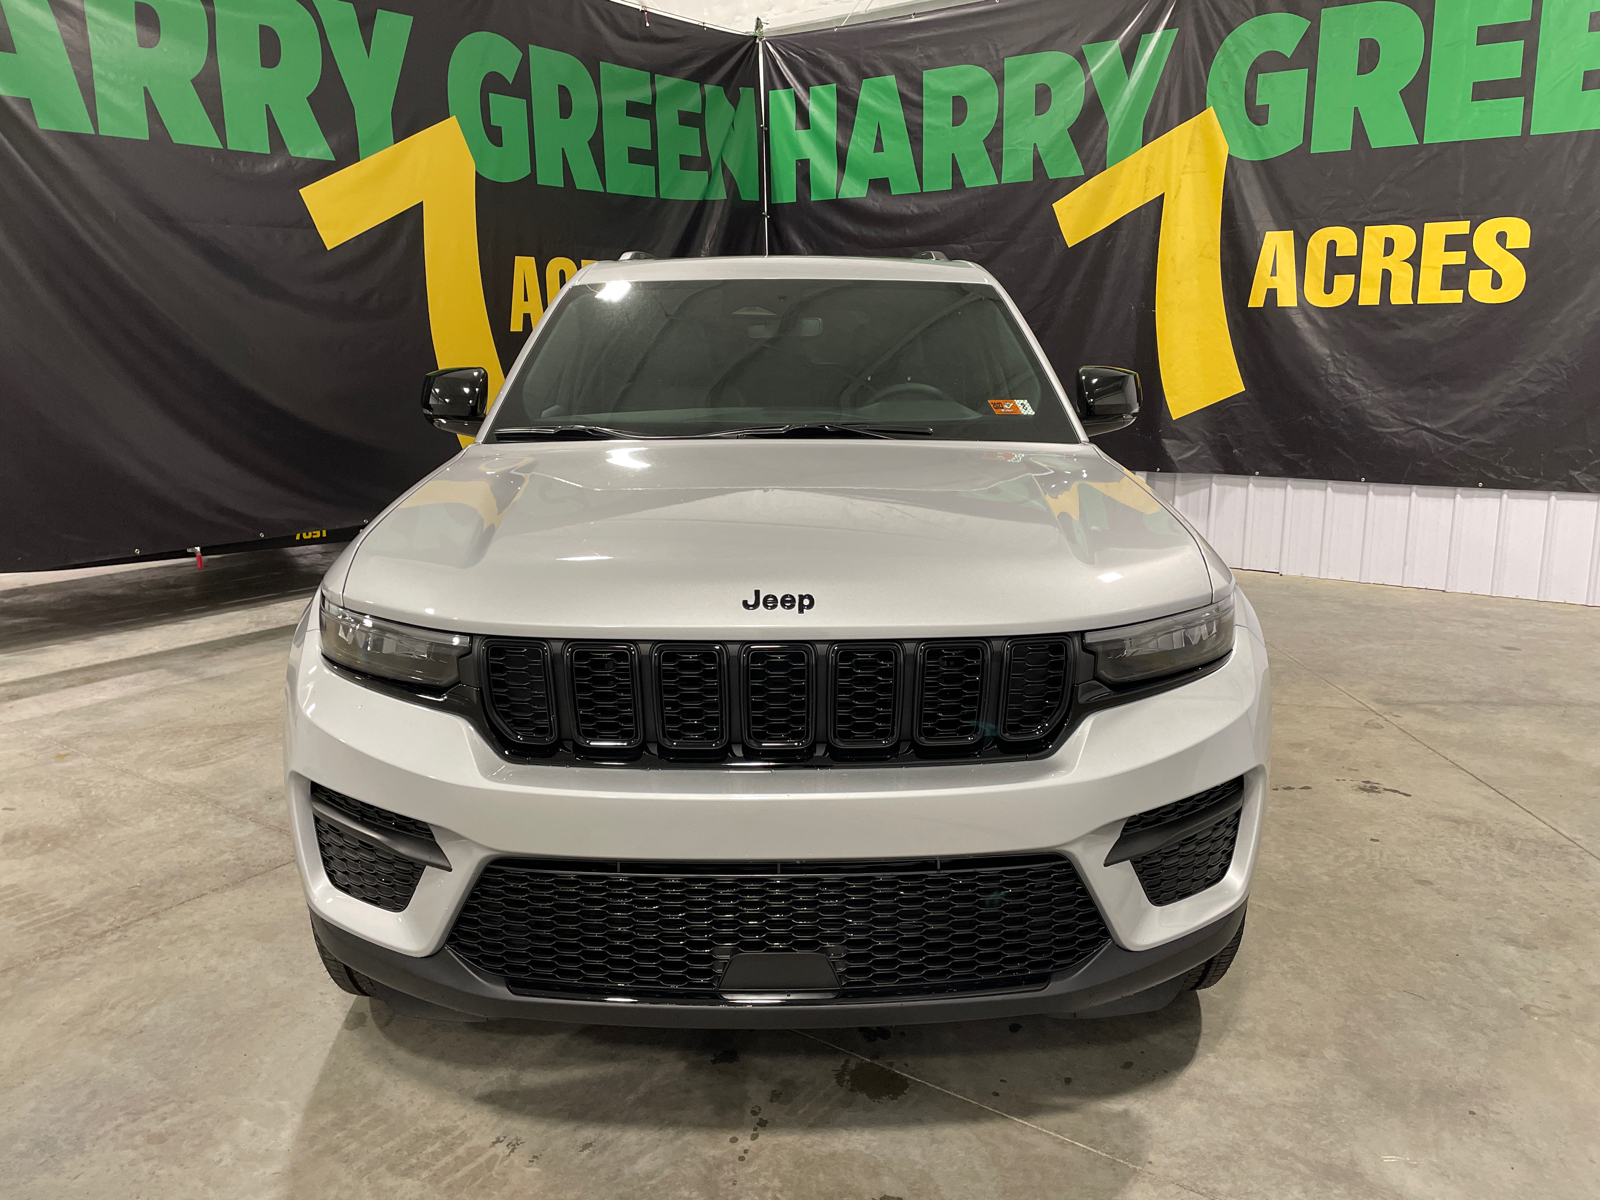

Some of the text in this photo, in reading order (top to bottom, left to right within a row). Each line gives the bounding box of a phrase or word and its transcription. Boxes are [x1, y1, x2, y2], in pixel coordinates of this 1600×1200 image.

[447, 31, 760, 202] GREEN
[768, 28, 1179, 204] HARRY
[300, 115, 506, 449] 7
[1053, 107, 1532, 420] 7 ACRES
[742, 589, 815, 615] Jeep
